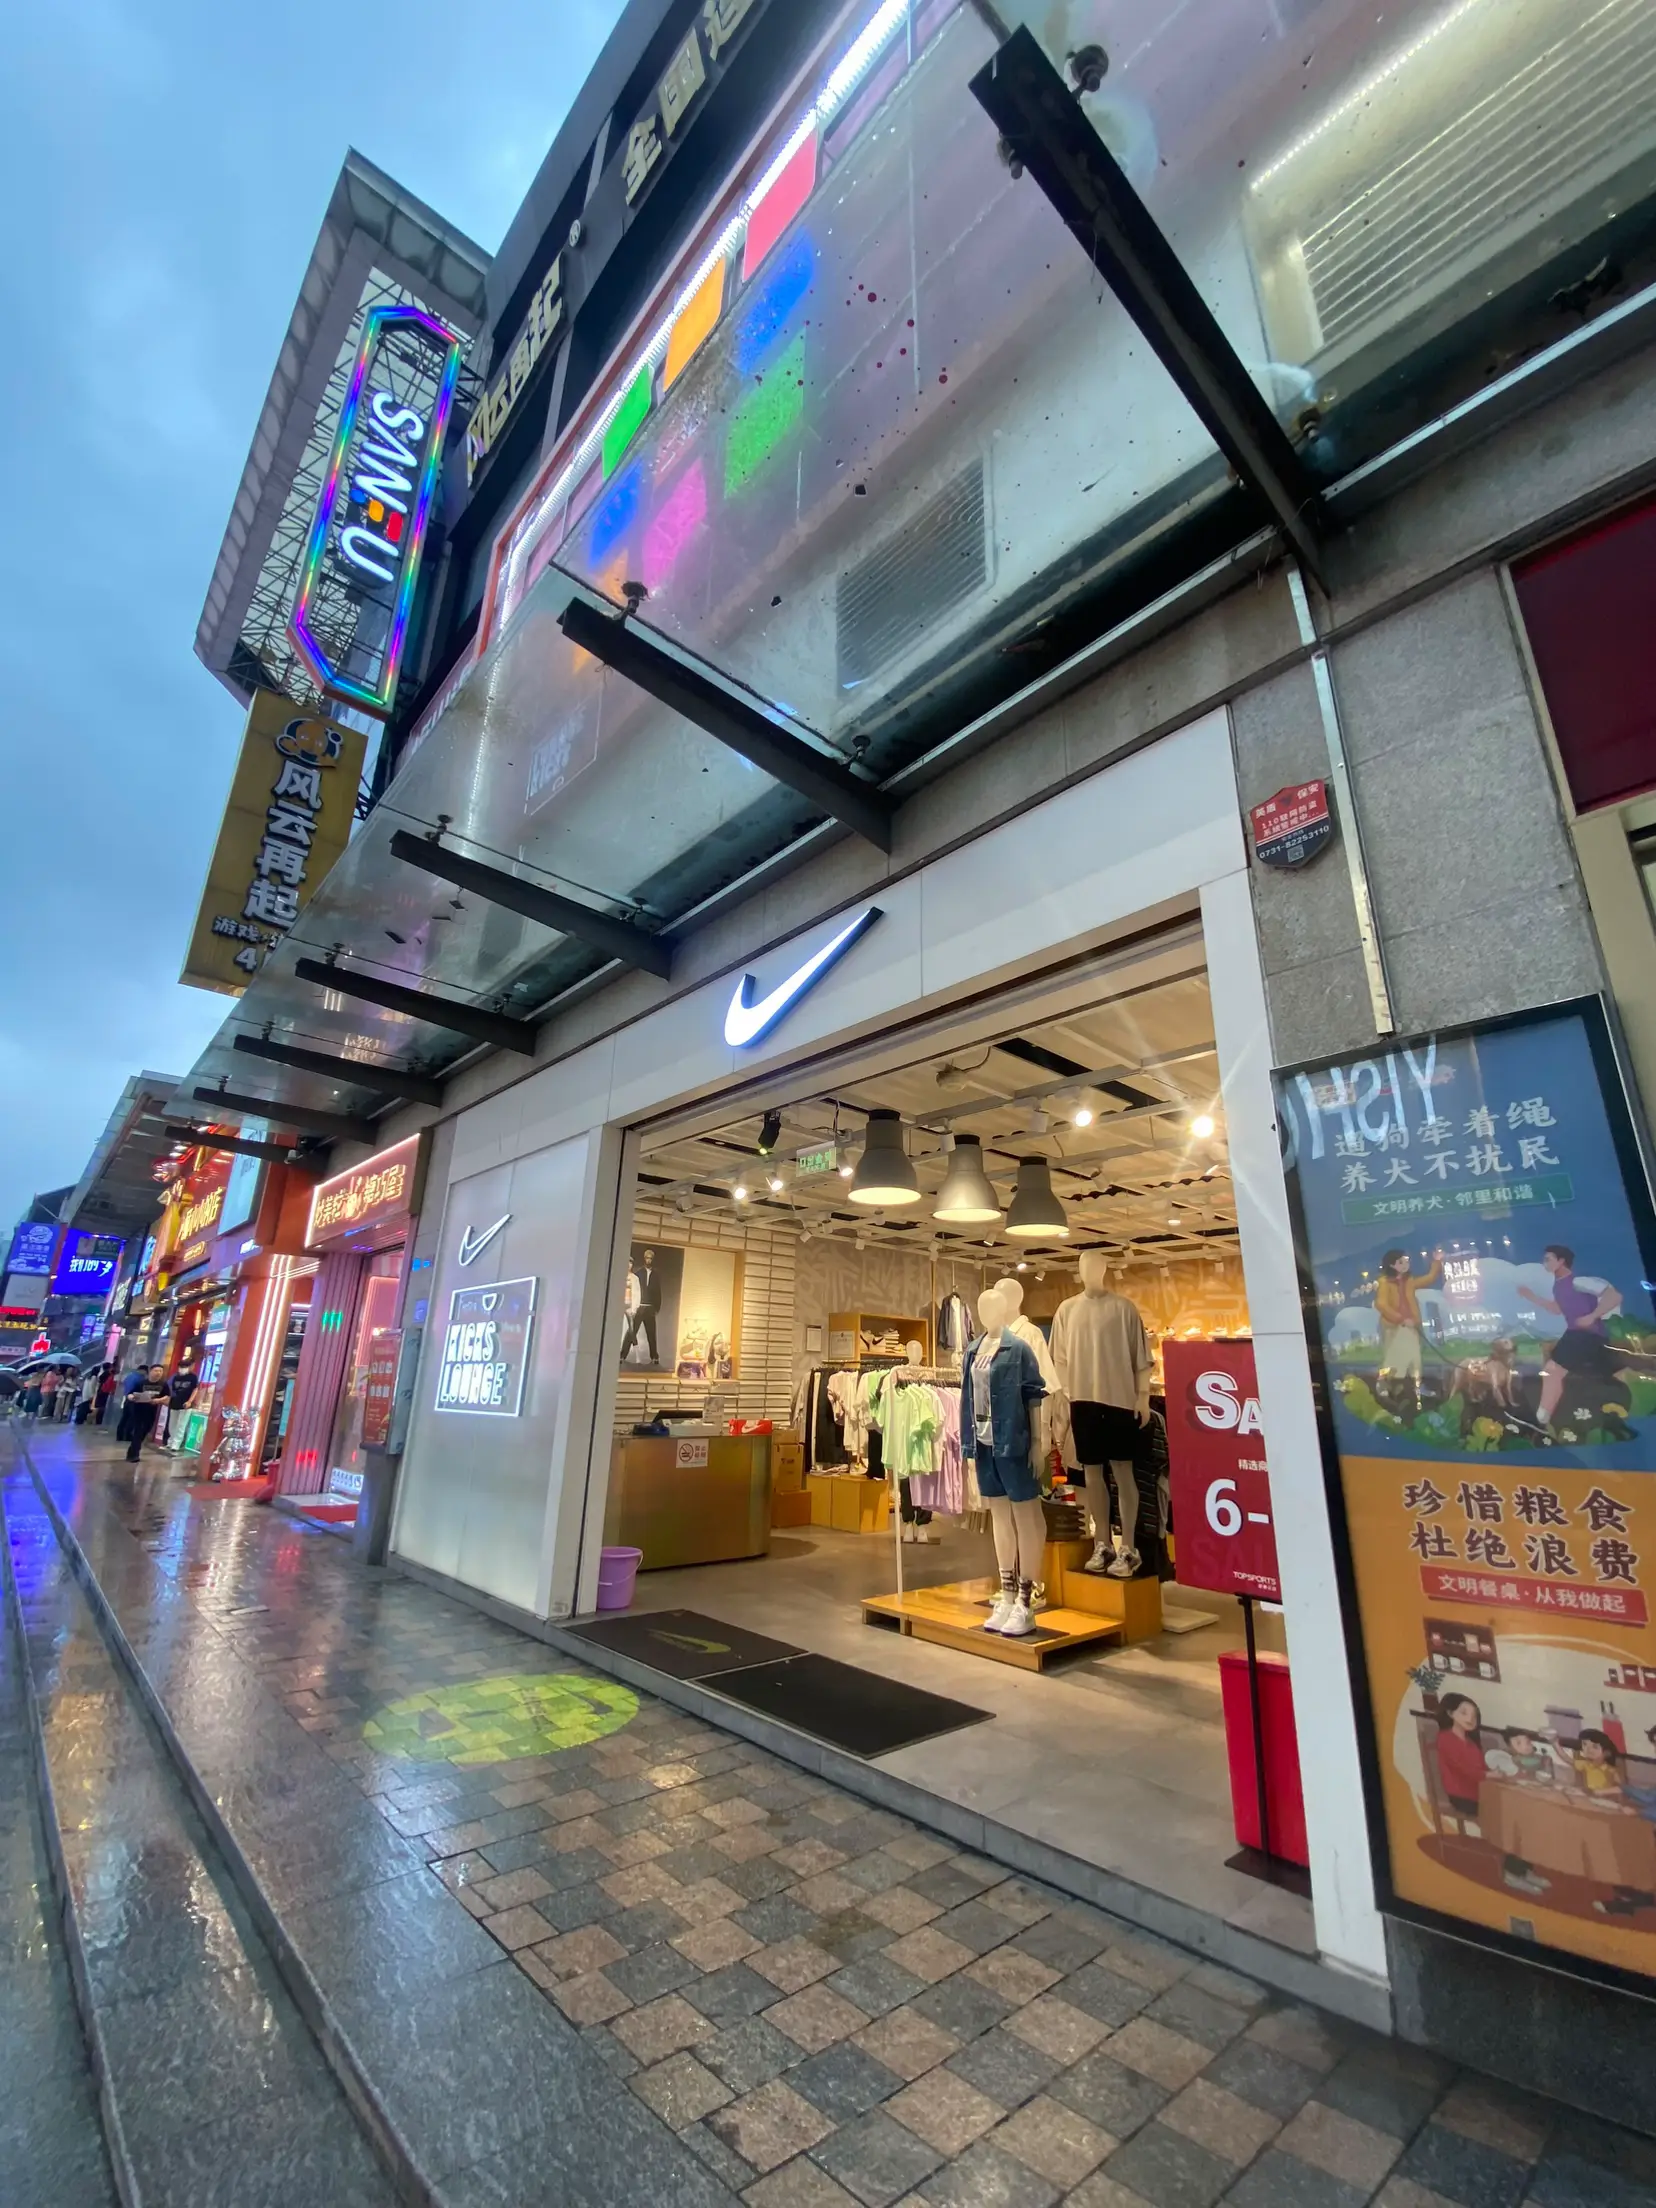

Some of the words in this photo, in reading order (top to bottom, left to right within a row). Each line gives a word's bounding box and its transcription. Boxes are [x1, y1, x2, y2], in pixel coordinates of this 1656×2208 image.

[243, 759, 323, 930] 风云再起
[1340, 1135, 1560, 1194] 养犬不扰民
[446, 1321, 497, 1362] KICKS
[440, 1362, 507, 1405] LOUNGE
[1402, 1478, 1634, 1534] 珍惜粮食
[1409, 1521, 1639, 1585] 杜绝浪费
